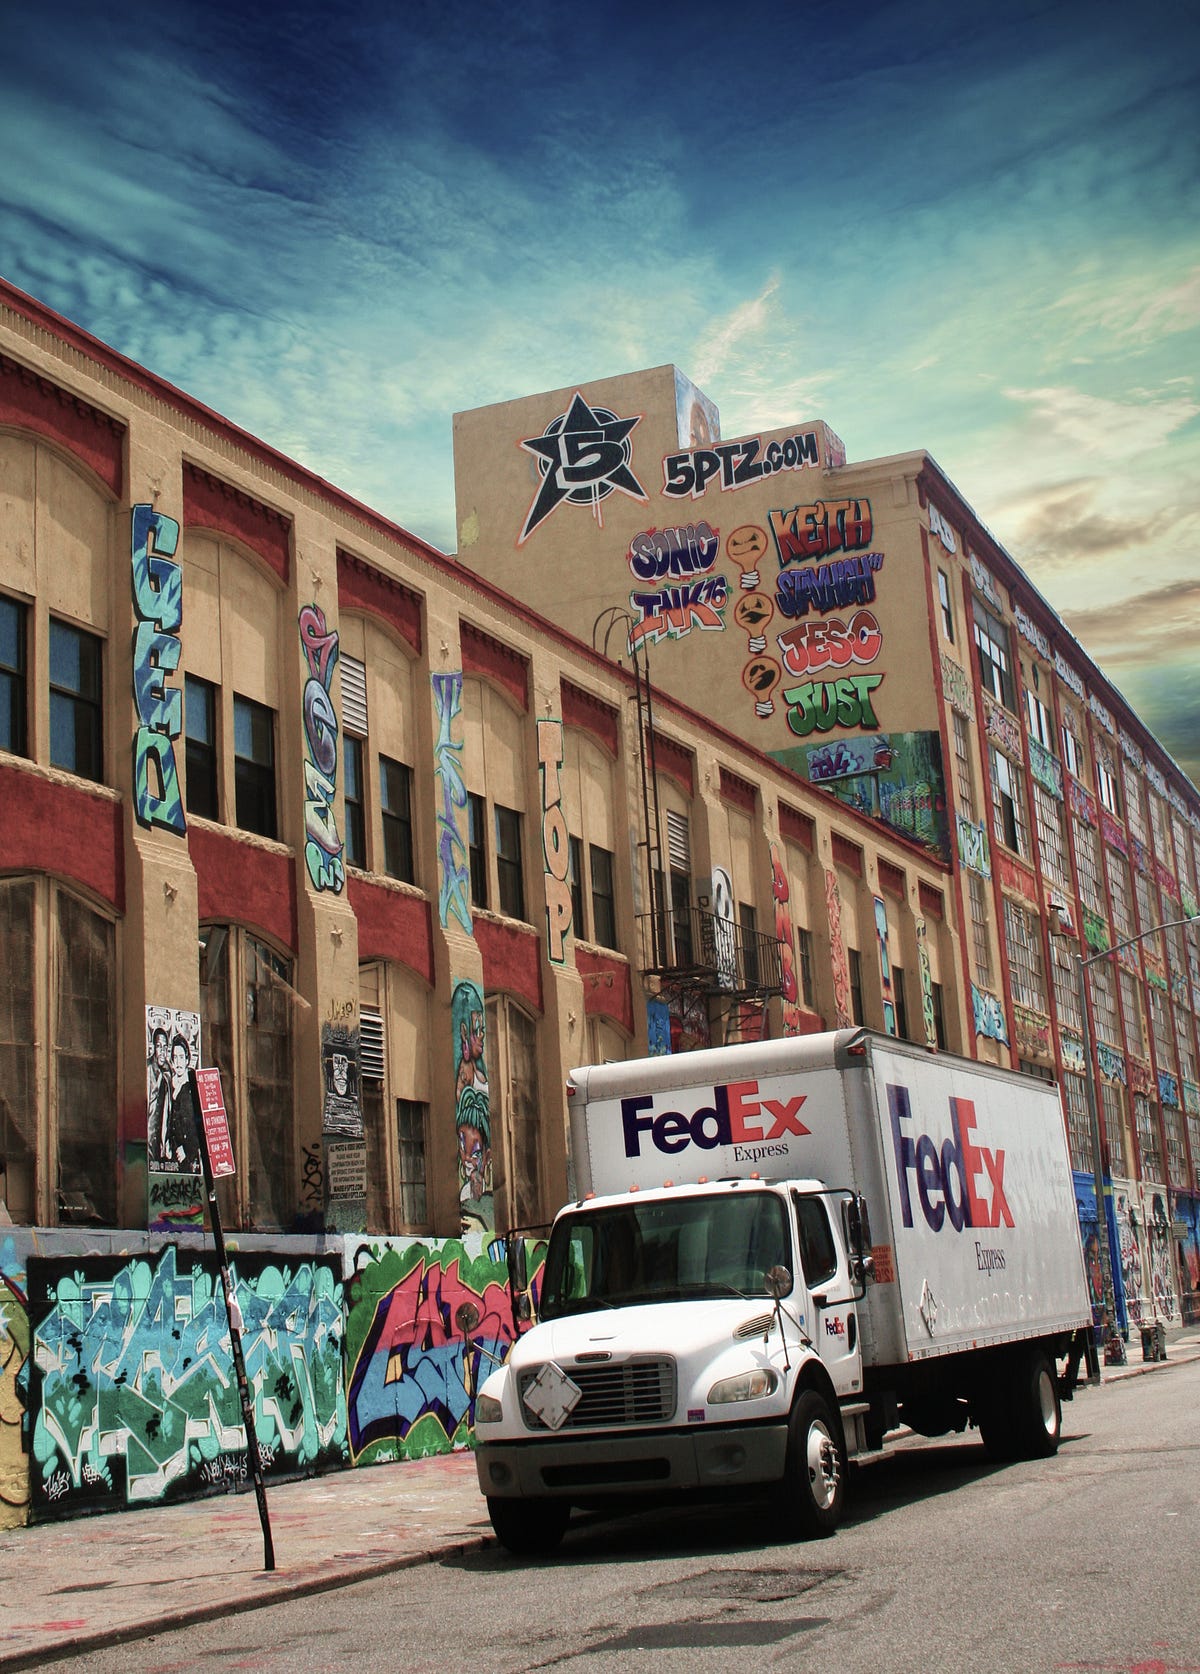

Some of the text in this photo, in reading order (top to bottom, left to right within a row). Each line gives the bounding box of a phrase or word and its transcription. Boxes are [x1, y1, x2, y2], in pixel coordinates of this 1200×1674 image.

[663, 432, 819, 500] 5PTZ.COM
[783, 673, 884, 737] JUST
[621, 1080, 812, 1158] FedEx
[733, 1143, 789, 1163] Express
[886, 1083, 1015, 1232] FedEx
[975, 1241, 1007, 1277] Express
[825, 1316, 845, 1335] FedEx
